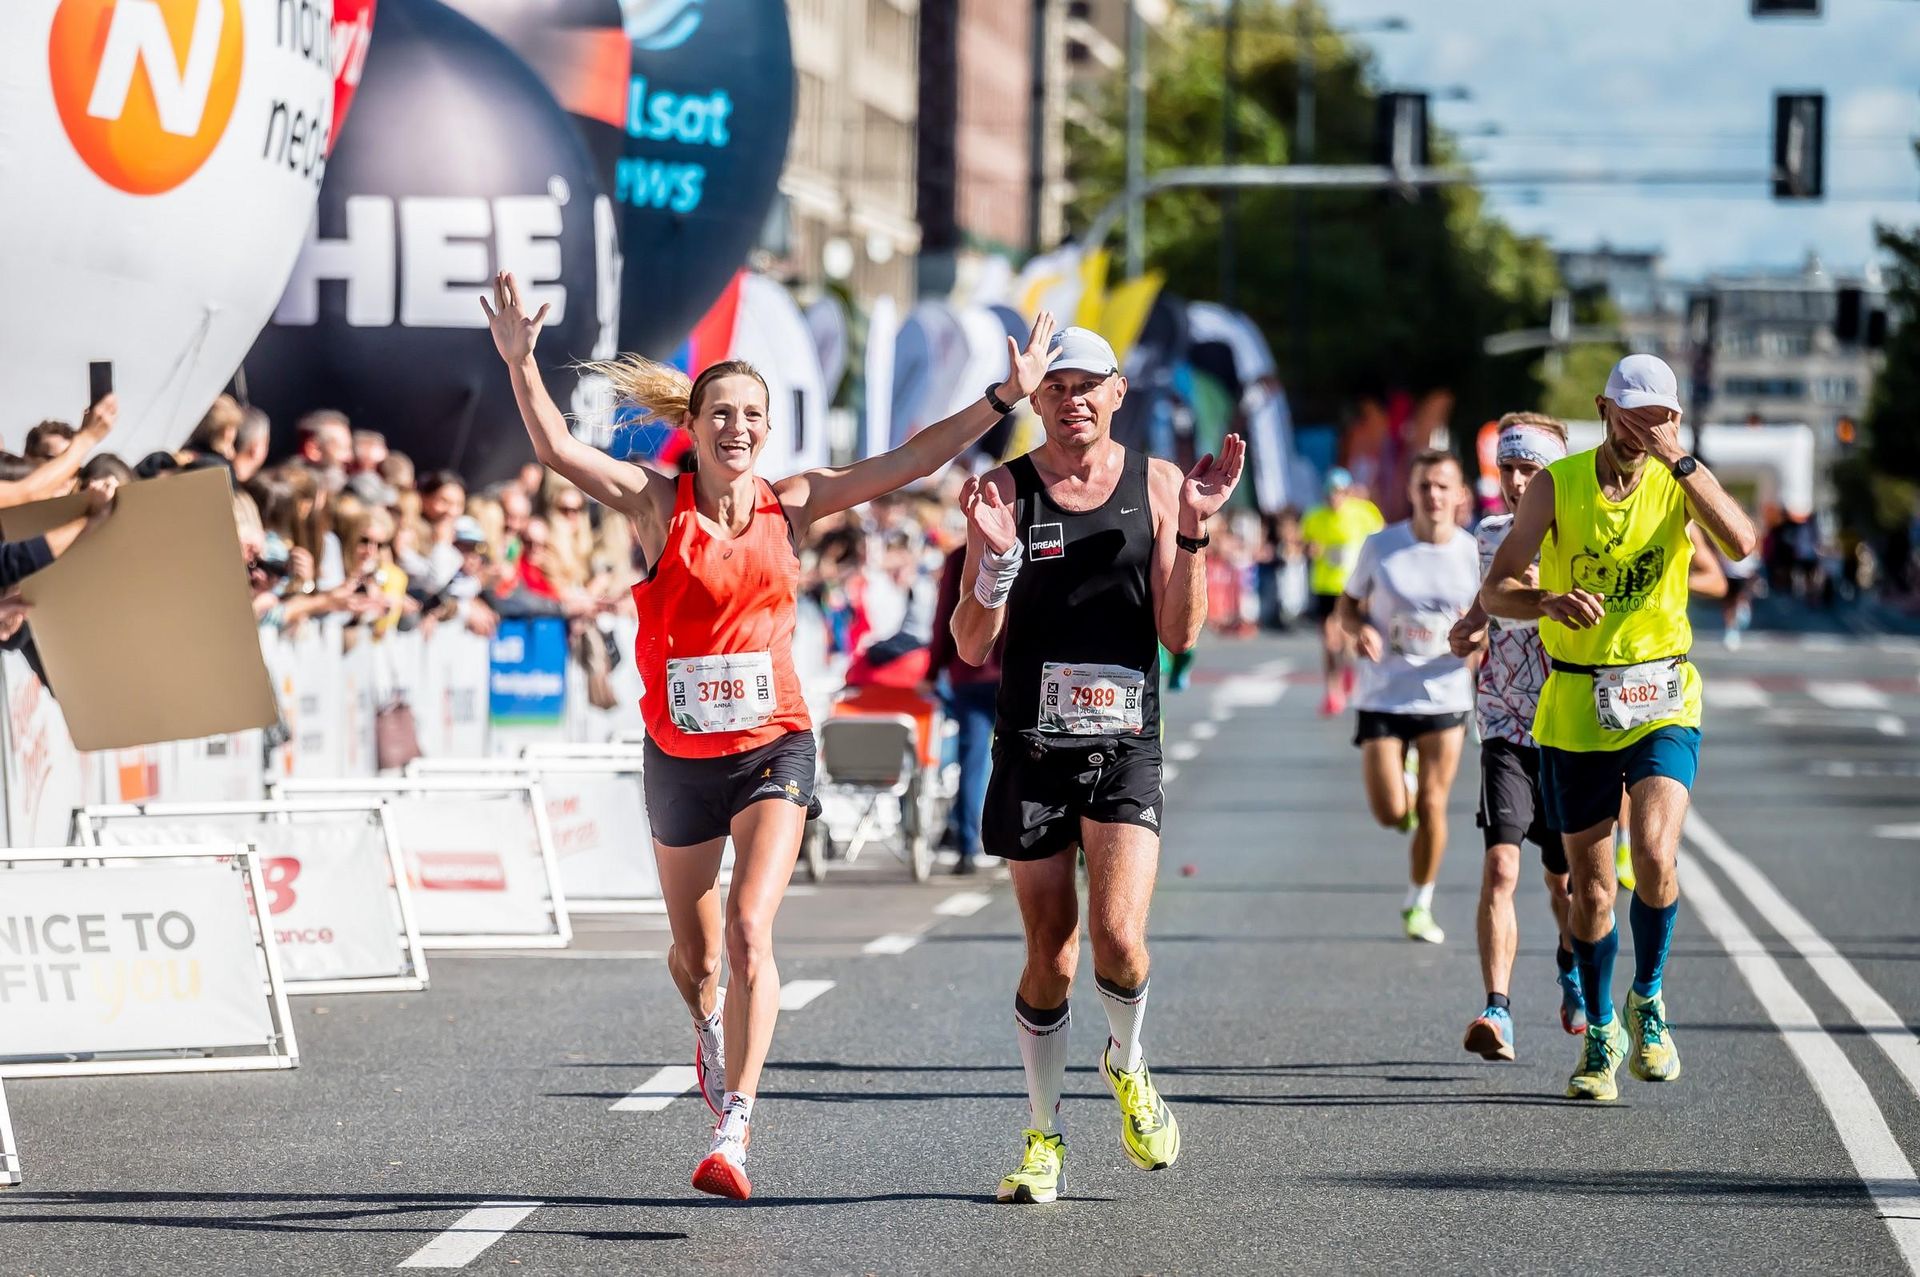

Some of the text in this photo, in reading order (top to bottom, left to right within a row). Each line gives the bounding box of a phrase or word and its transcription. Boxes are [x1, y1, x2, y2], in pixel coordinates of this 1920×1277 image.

[1031, 540, 1061, 551] DREAM
[697, 679, 745, 702] 3798
[1071, 686, 1115, 707] 7989
[1619, 685, 1658, 704] 4682
[0, 910, 196, 955] NICE TO
[0, 958, 202, 1025] FIT you
